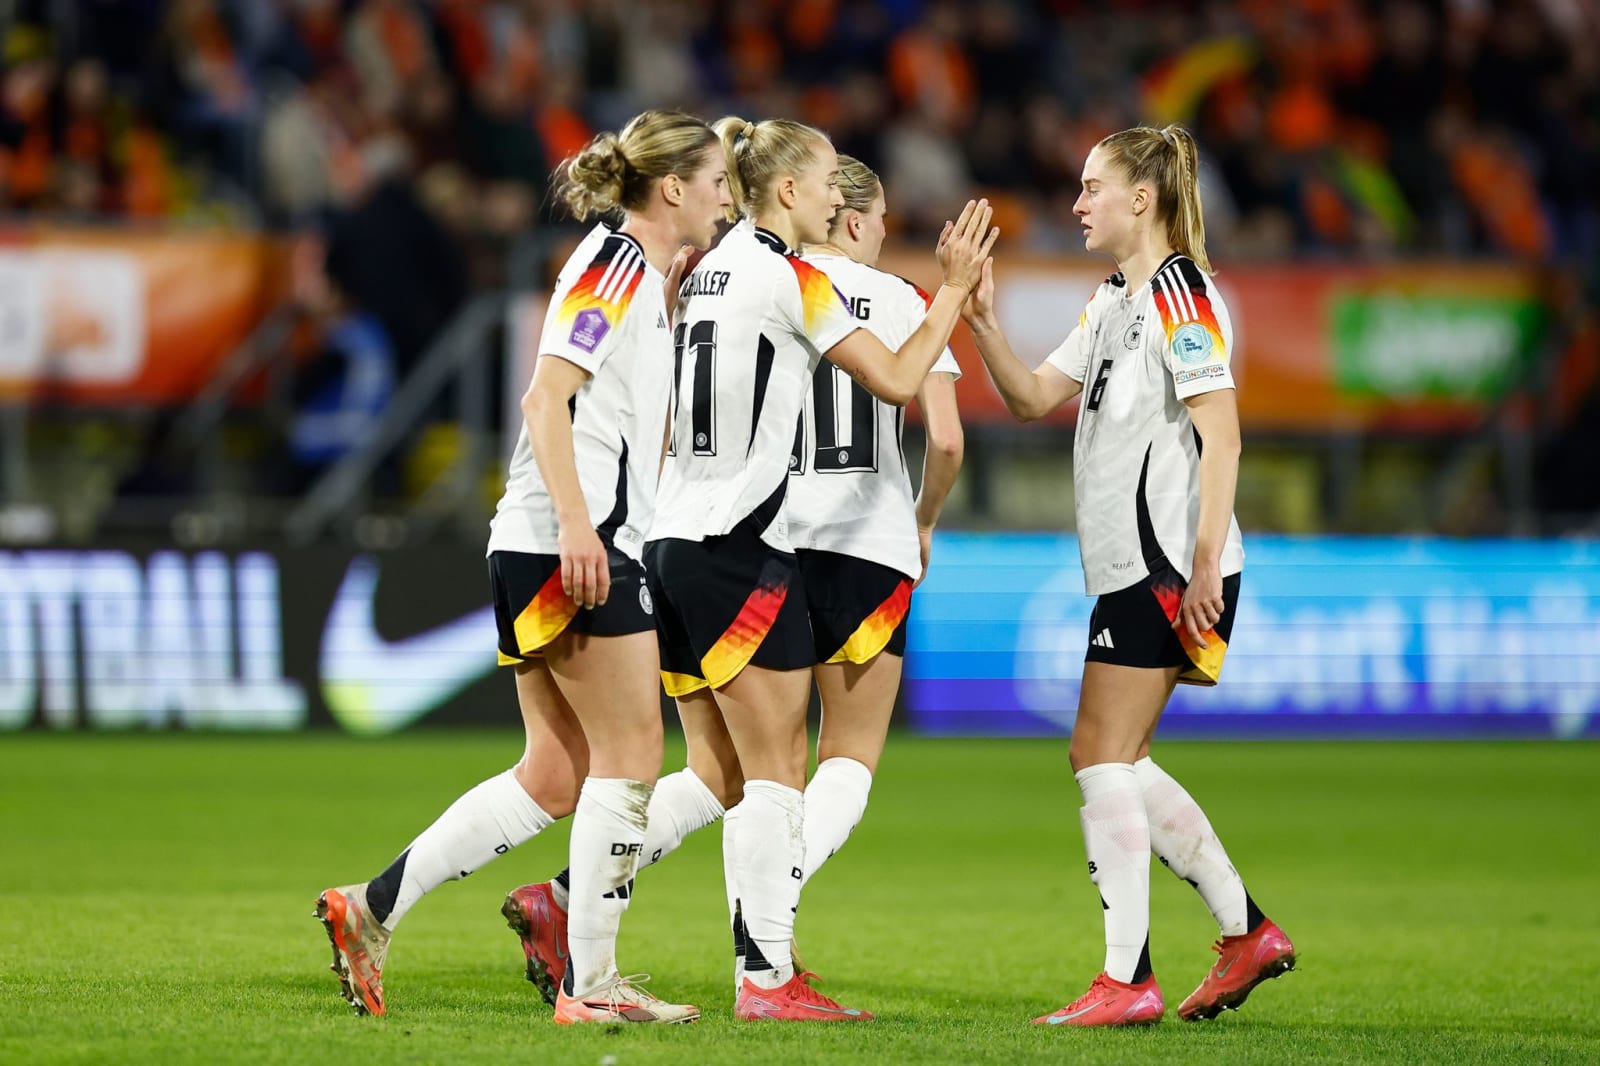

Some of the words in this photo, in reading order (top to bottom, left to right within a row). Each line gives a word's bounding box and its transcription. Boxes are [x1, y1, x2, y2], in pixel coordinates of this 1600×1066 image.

[1087, 359, 1113, 413] 6
[1175, 366, 1224, 382] FOUNDATION
[788, 355, 879, 475] 0
